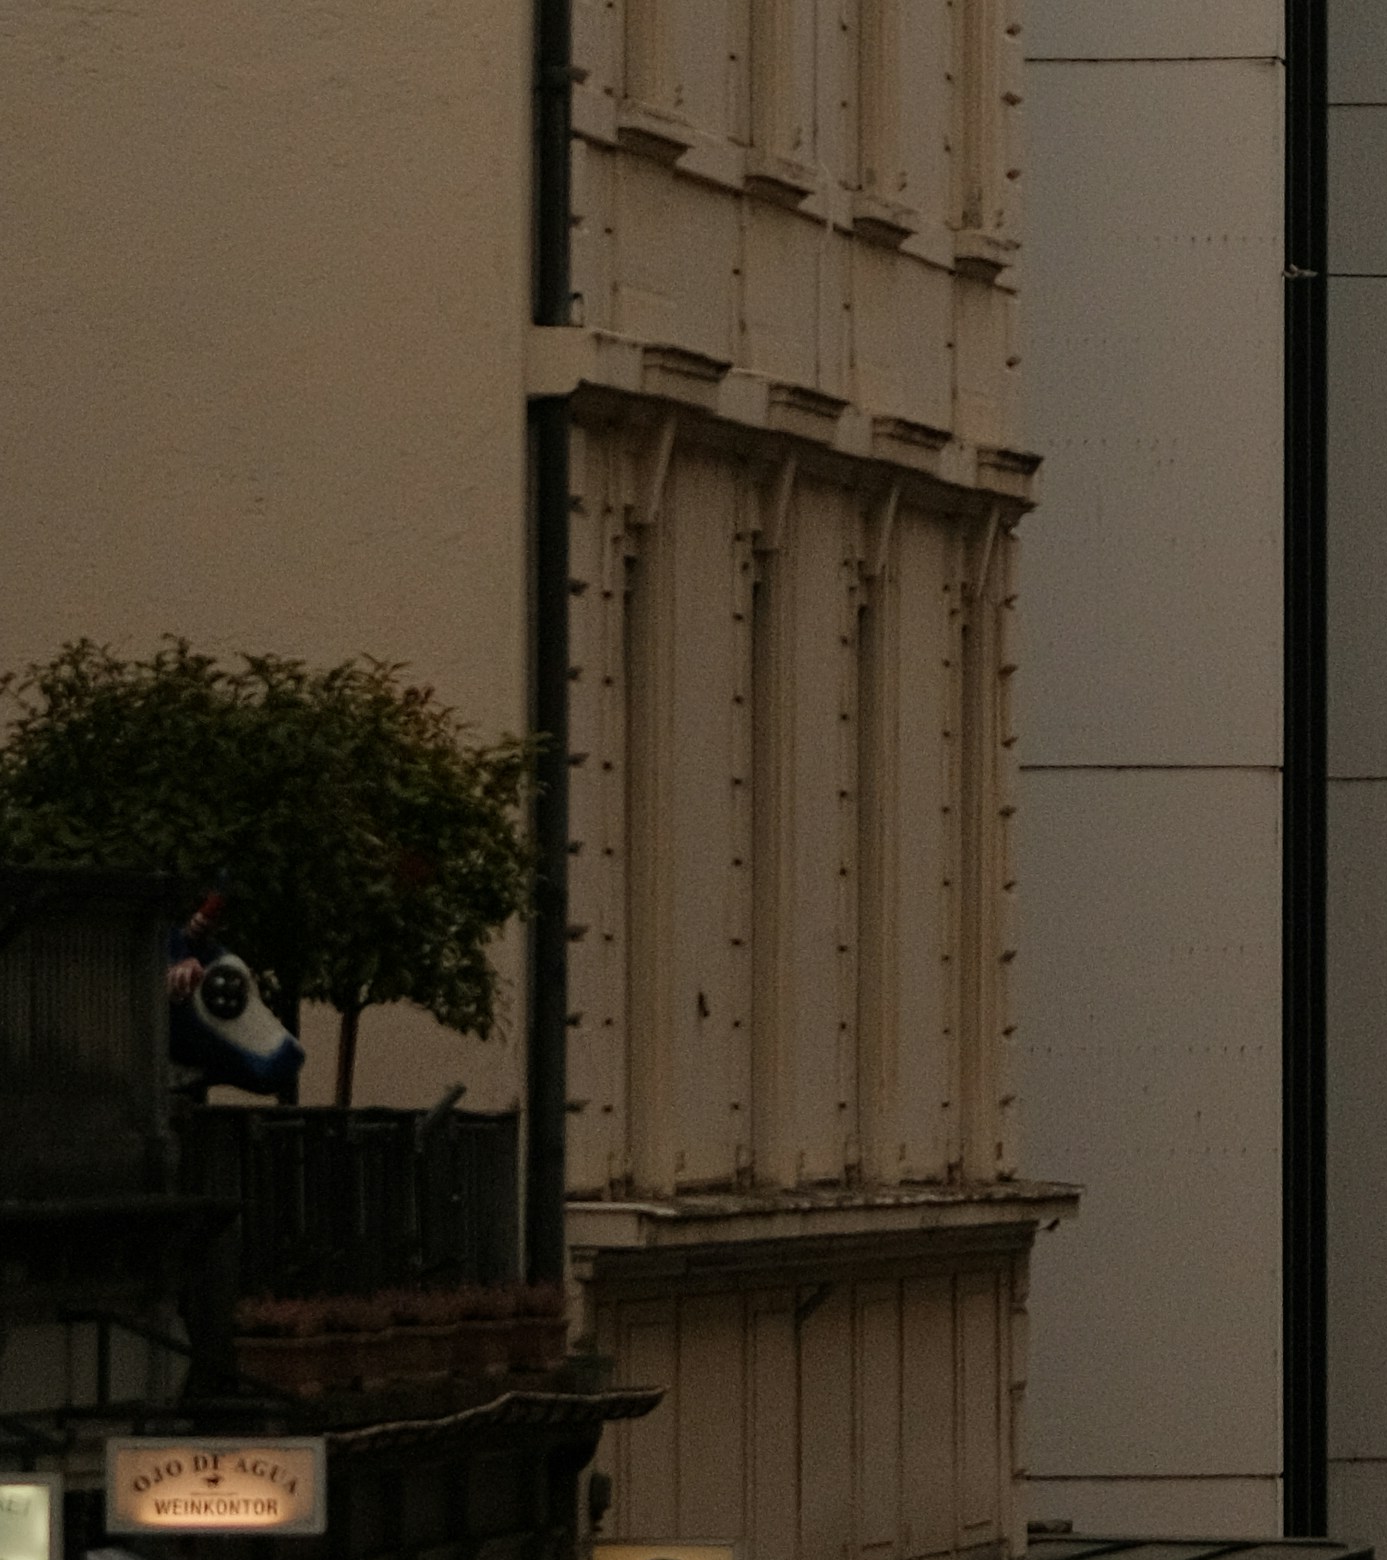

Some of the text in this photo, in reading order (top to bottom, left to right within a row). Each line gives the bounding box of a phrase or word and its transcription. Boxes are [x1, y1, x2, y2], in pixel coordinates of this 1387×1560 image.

[134, 1459, 183, 1494] OJO
[236, 1458, 298, 1494] AGUA
[155, 1499, 279, 1516] WEINKONTOR
